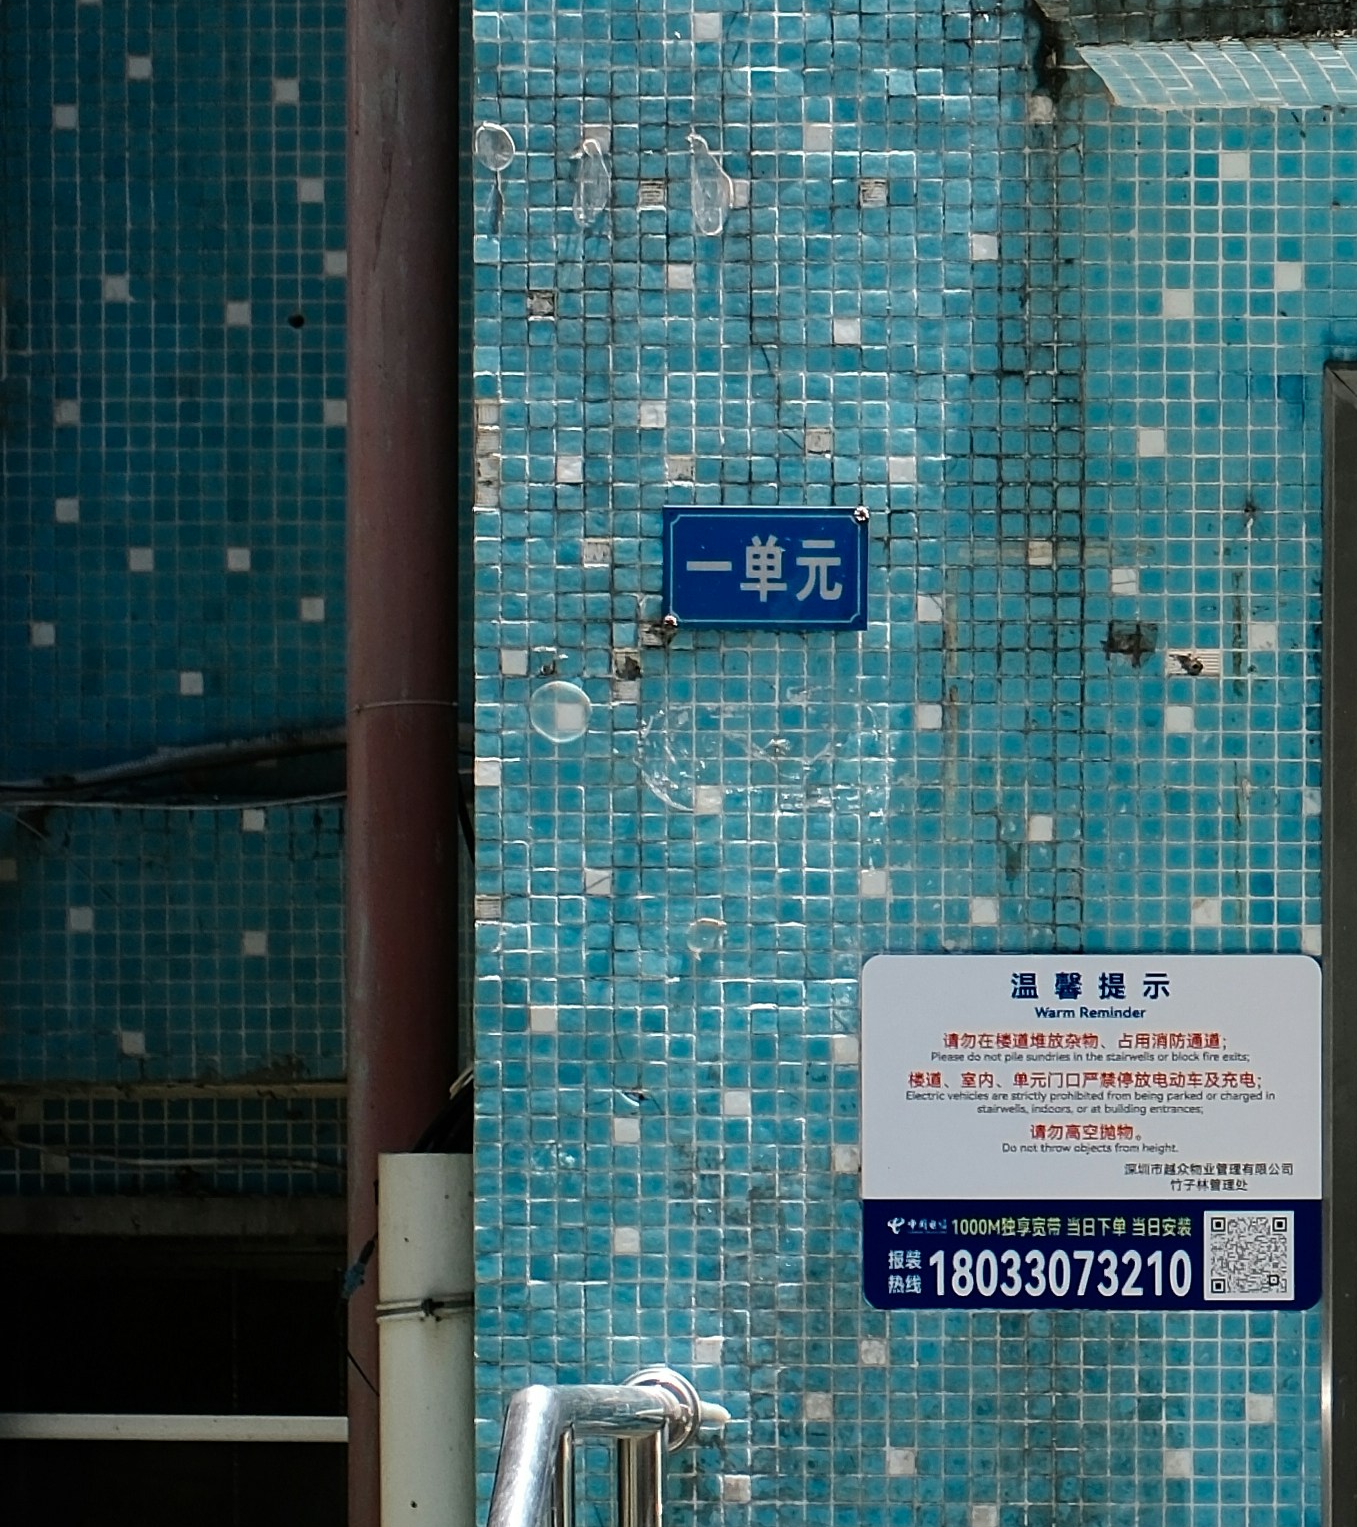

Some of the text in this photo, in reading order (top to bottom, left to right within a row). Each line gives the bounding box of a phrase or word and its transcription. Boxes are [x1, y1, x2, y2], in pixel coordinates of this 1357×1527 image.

[686, 535, 842, 602] 一单元
[1011, 972, 1170, 999] 温馨提示
[1035, 1006, 1146, 1018] Warm Reminder
[931, 1052, 964, 1061] Please
[967, 1052, 981, 1061] do
[984, 1053, 1002, 1061] not
[1005, 1052, 1023, 1062] pile
[1027, 1052, 1070, 1061] sundries
[1073, 1053, 1082, 1061] in
[1086, 1053, 1103, 1061] the
[1106, 1052, 1155, 1061] stairwells
[1172, 1052, 1199, 1061] block
[1203, 1052, 1219, 1061] fire
[906, 1091, 944, 1100] Electric
[947, 1091, 988, 1100] vehicles
[1011, 1091, 1046, 1102] strictly
[1050, 1091, 1103, 1102] prohibited
[1107, 1091, 1131, 1100] from
[1134, 1091, 1163, 1102] being
[1167, 1091, 1202, 1102] parked
[1220, 1091, 1262, 1102] charged
[1266, 1092, 1275, 1100] in
[977, 1105, 1029, 1114] stairwells,
[1031, 1105, 1073, 1114] indoors,
[1105, 1105, 1146, 1115] building
[1002, 1143, 1178, 1154] Do not throw objects from height.
[952, 1217, 1061, 1236] 1000M独享宽带
[1067, 1217, 1126, 1236] 当日下单
[1132, 1217, 1191, 1236] 当日安装
[888, 1250, 922, 1270] 报装
[929, 1249, 1191, 1296] 18033073210
[888, 1275, 921, 1294] 热线
